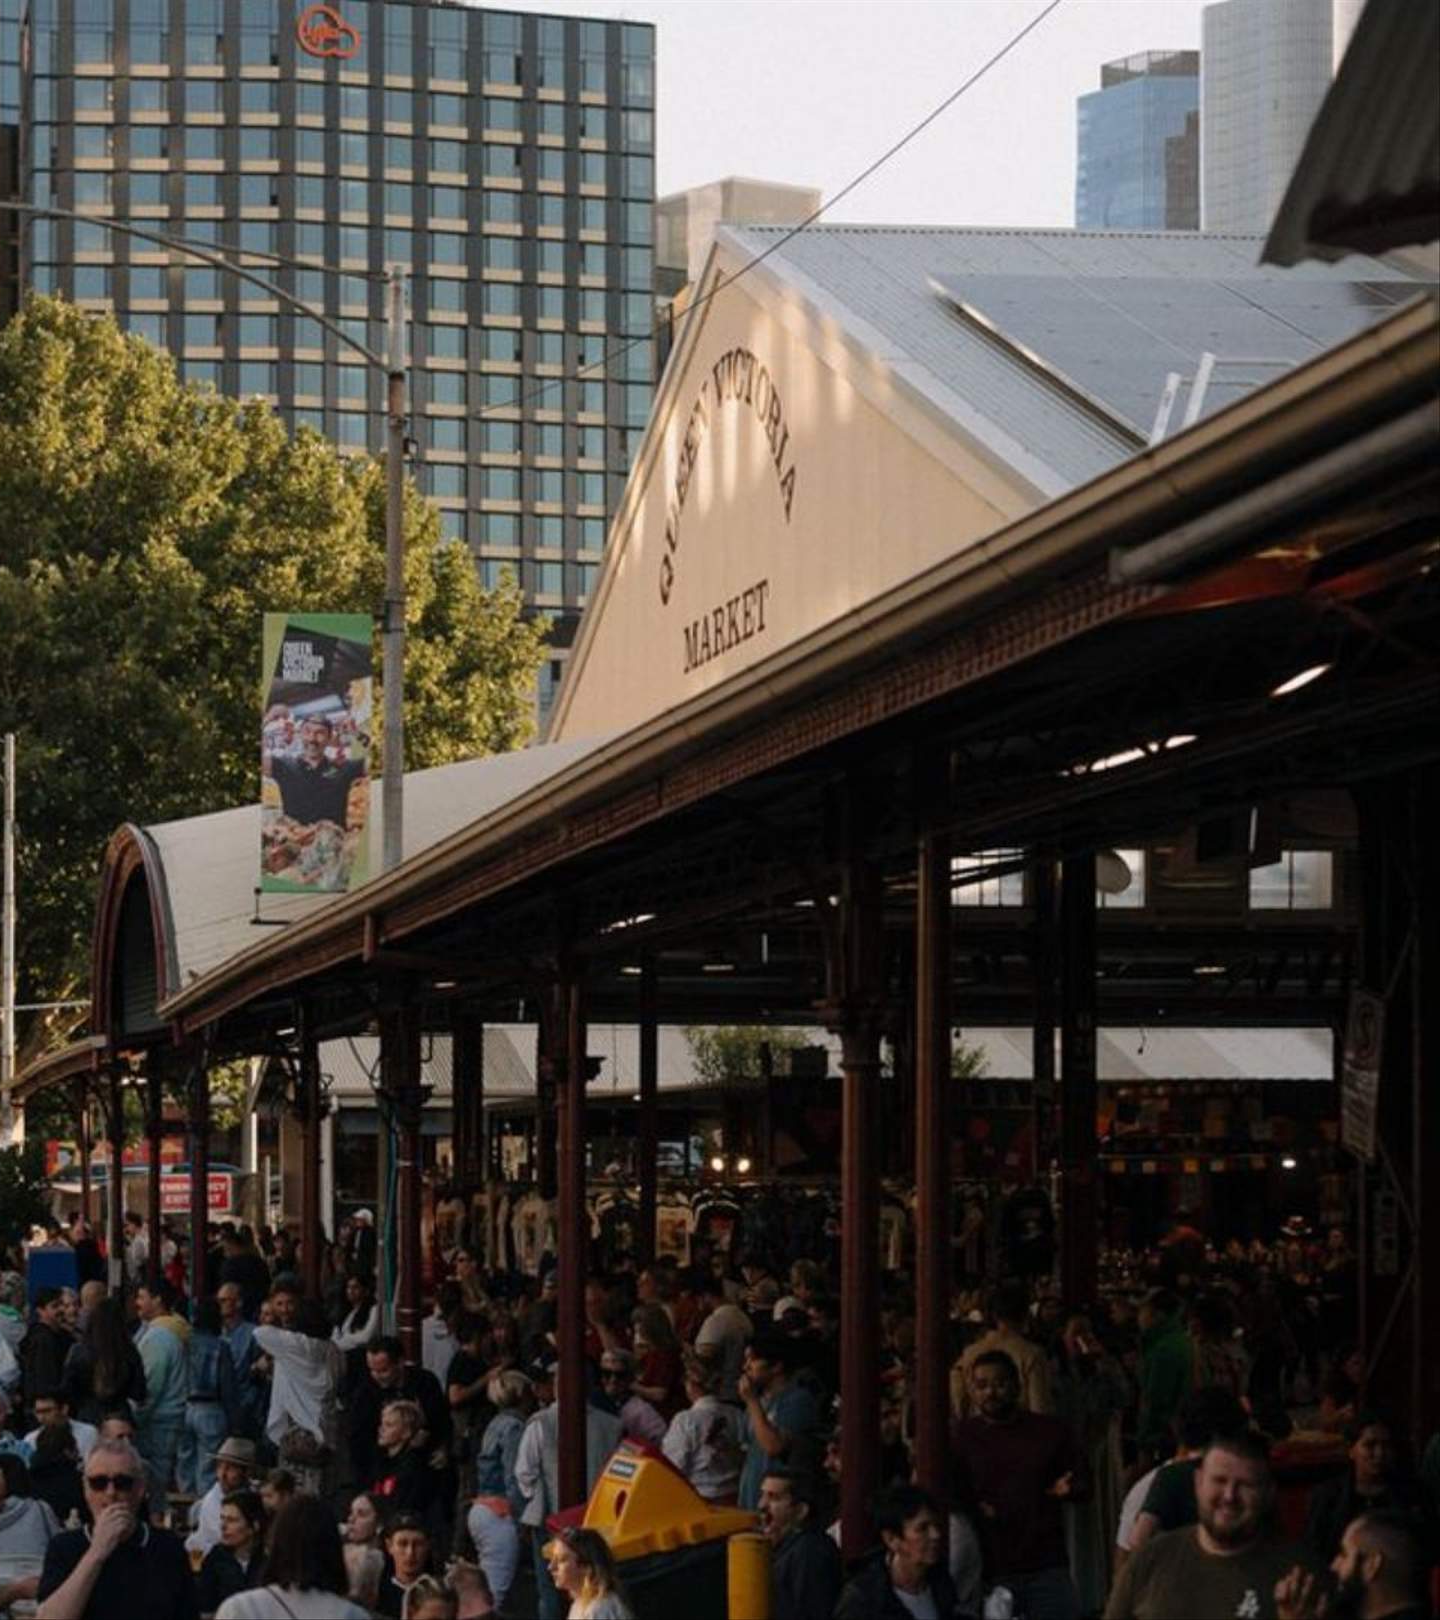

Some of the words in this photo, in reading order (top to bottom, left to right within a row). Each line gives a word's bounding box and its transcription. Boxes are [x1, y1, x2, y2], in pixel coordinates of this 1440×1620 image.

[659, 380, 709, 606] QUEEN
[712, 347, 797, 525] VICTORIA
[683, 578, 769, 675] MARKET
